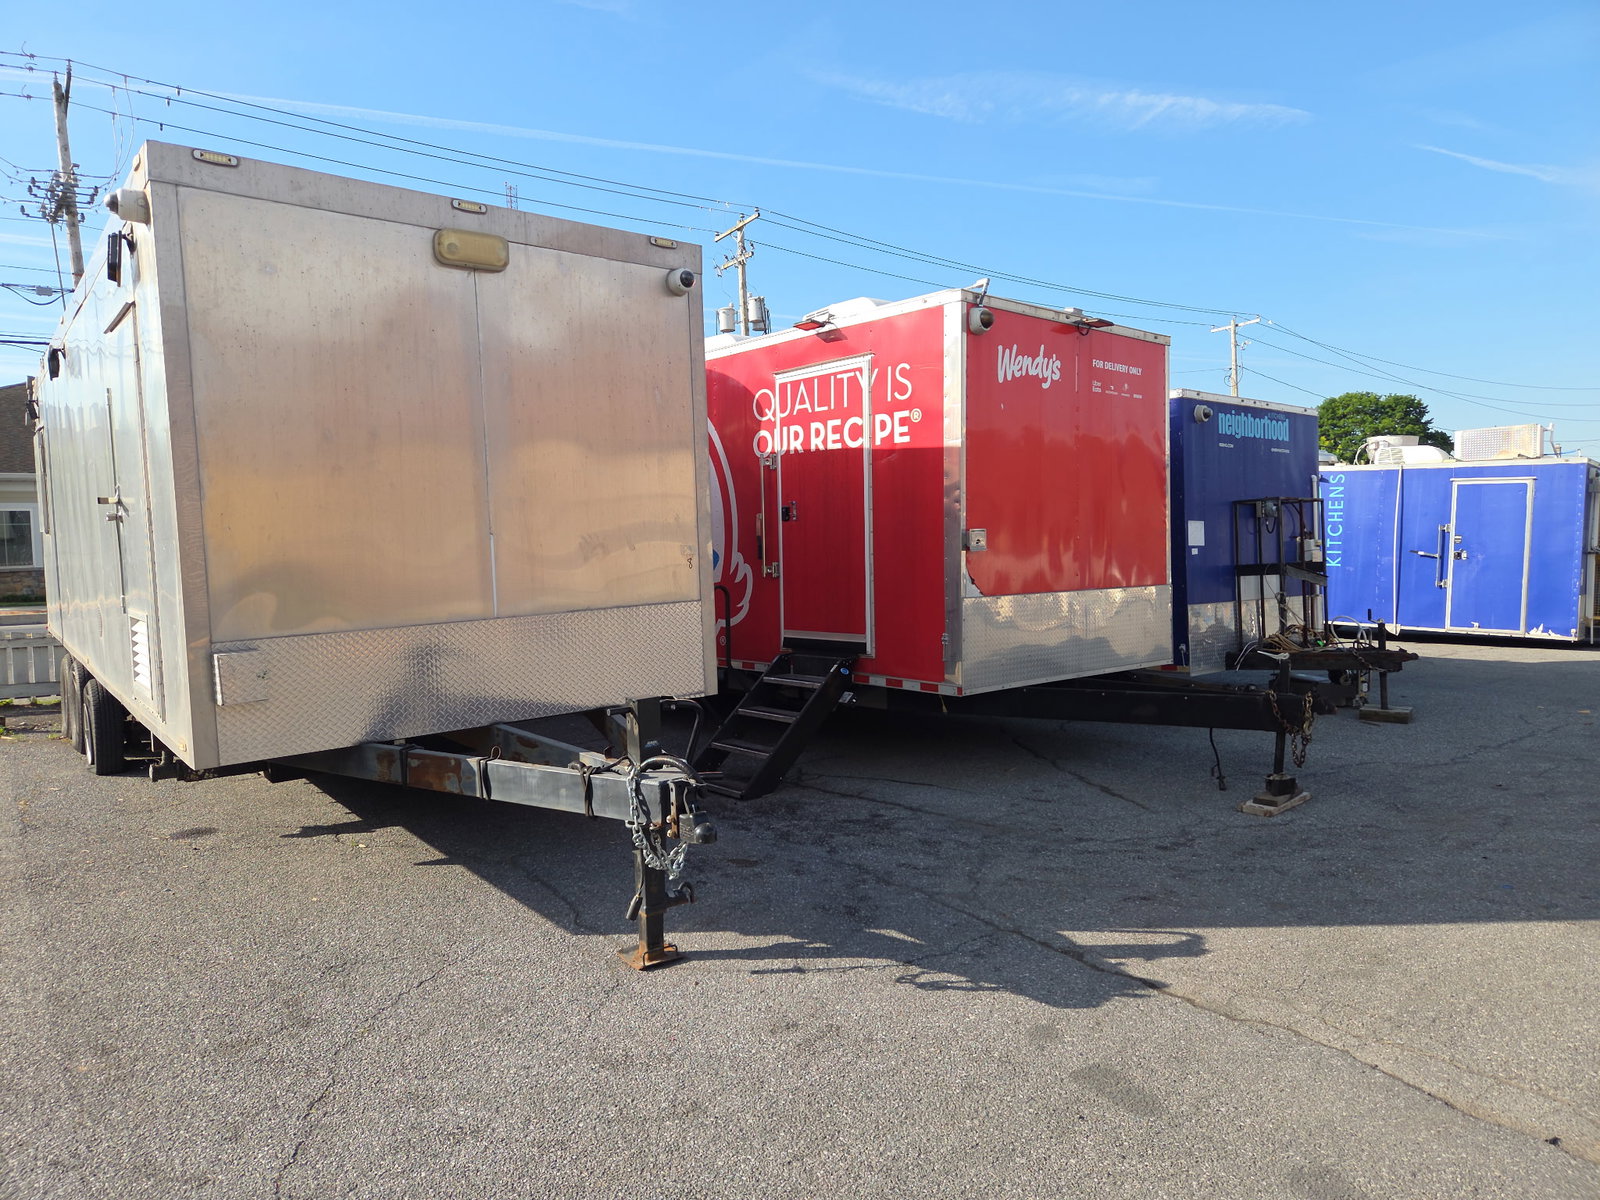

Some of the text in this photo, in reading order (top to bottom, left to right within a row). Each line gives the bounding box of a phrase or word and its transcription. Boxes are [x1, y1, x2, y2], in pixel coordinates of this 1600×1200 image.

[997, 344, 1061, 389] Wendy's
[1092, 359, 1143, 376] FOR DELIVERY ONLY
[752, 363, 913, 422] QUALITY IS
[752, 408, 922, 458] OUR RECPE®
[1218, 409, 1290, 442] neighborhood
[1326, 473, 1345, 567] KITCHENS
